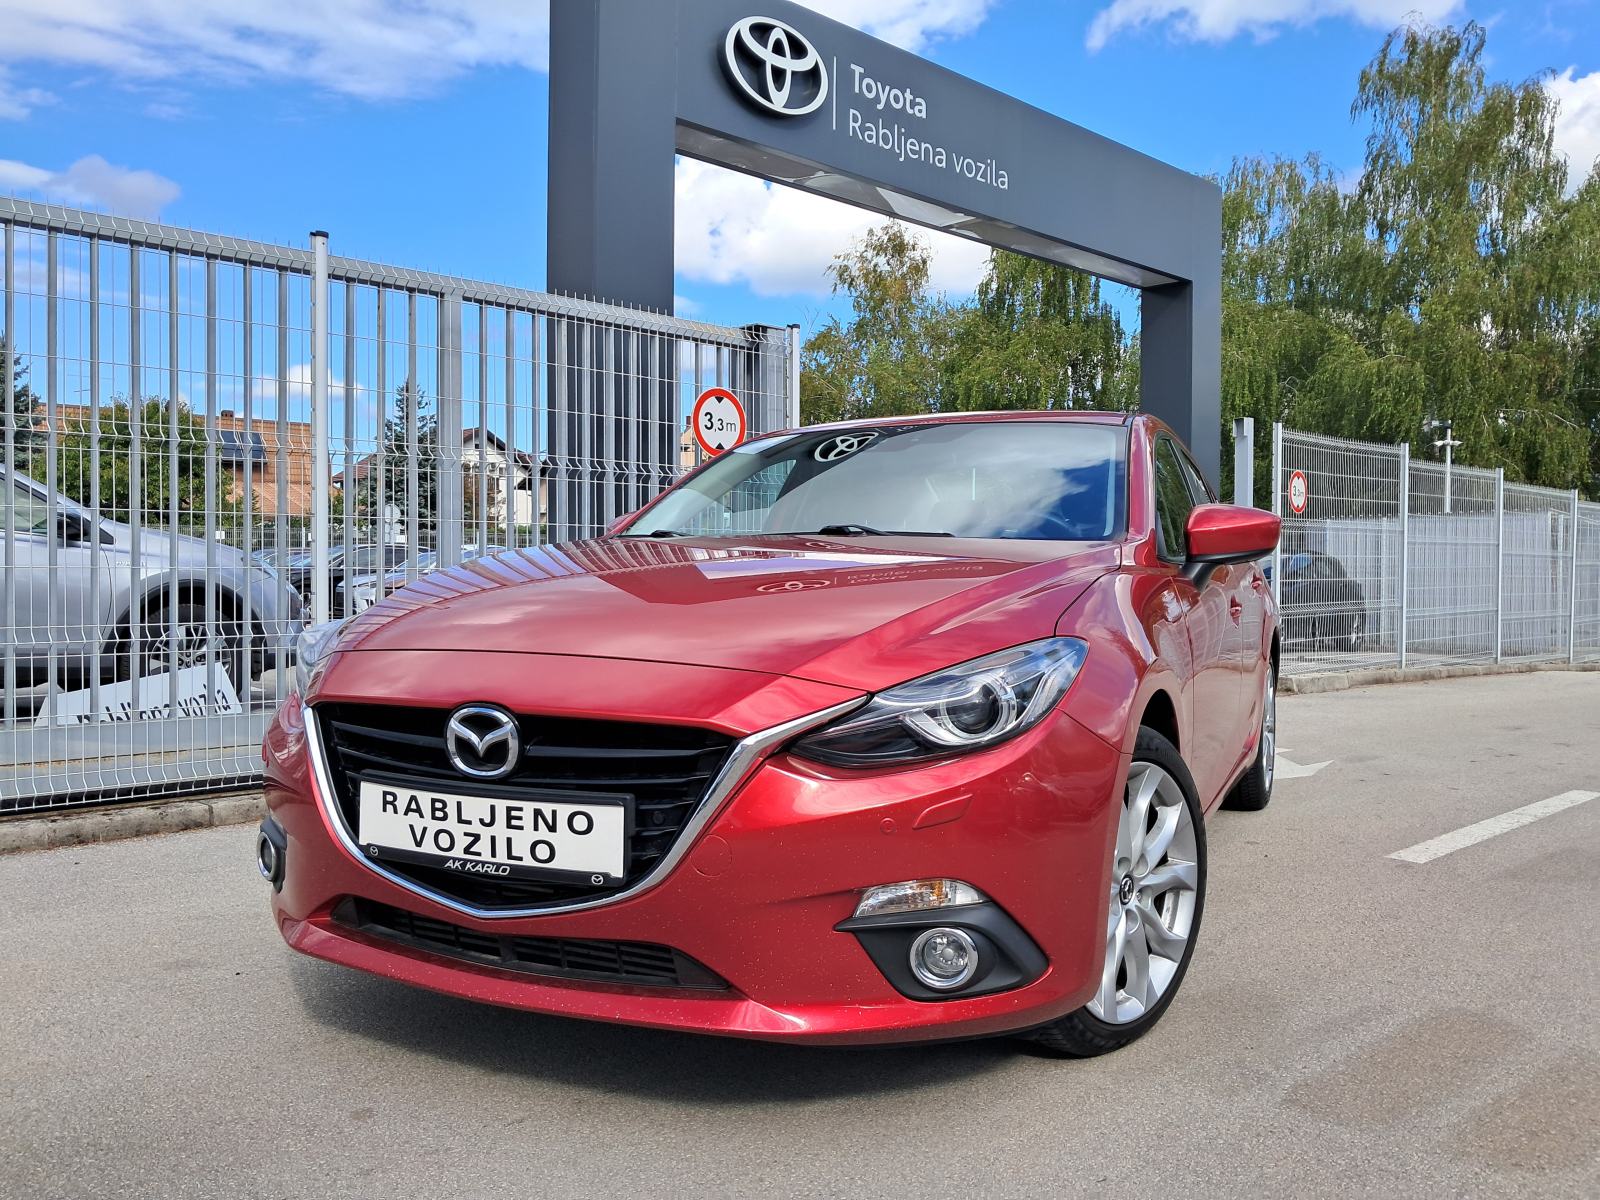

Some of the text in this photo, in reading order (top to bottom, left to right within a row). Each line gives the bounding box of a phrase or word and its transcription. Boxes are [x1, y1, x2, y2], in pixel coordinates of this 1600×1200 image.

[851, 64, 926, 118] Toyota
[850, 109, 1008, 189] Rabljena vozila
[382, 790, 594, 835] RABLJENO
[408, 824, 556, 863] VOZILO
[444, 859, 510, 875] AK KARLO
